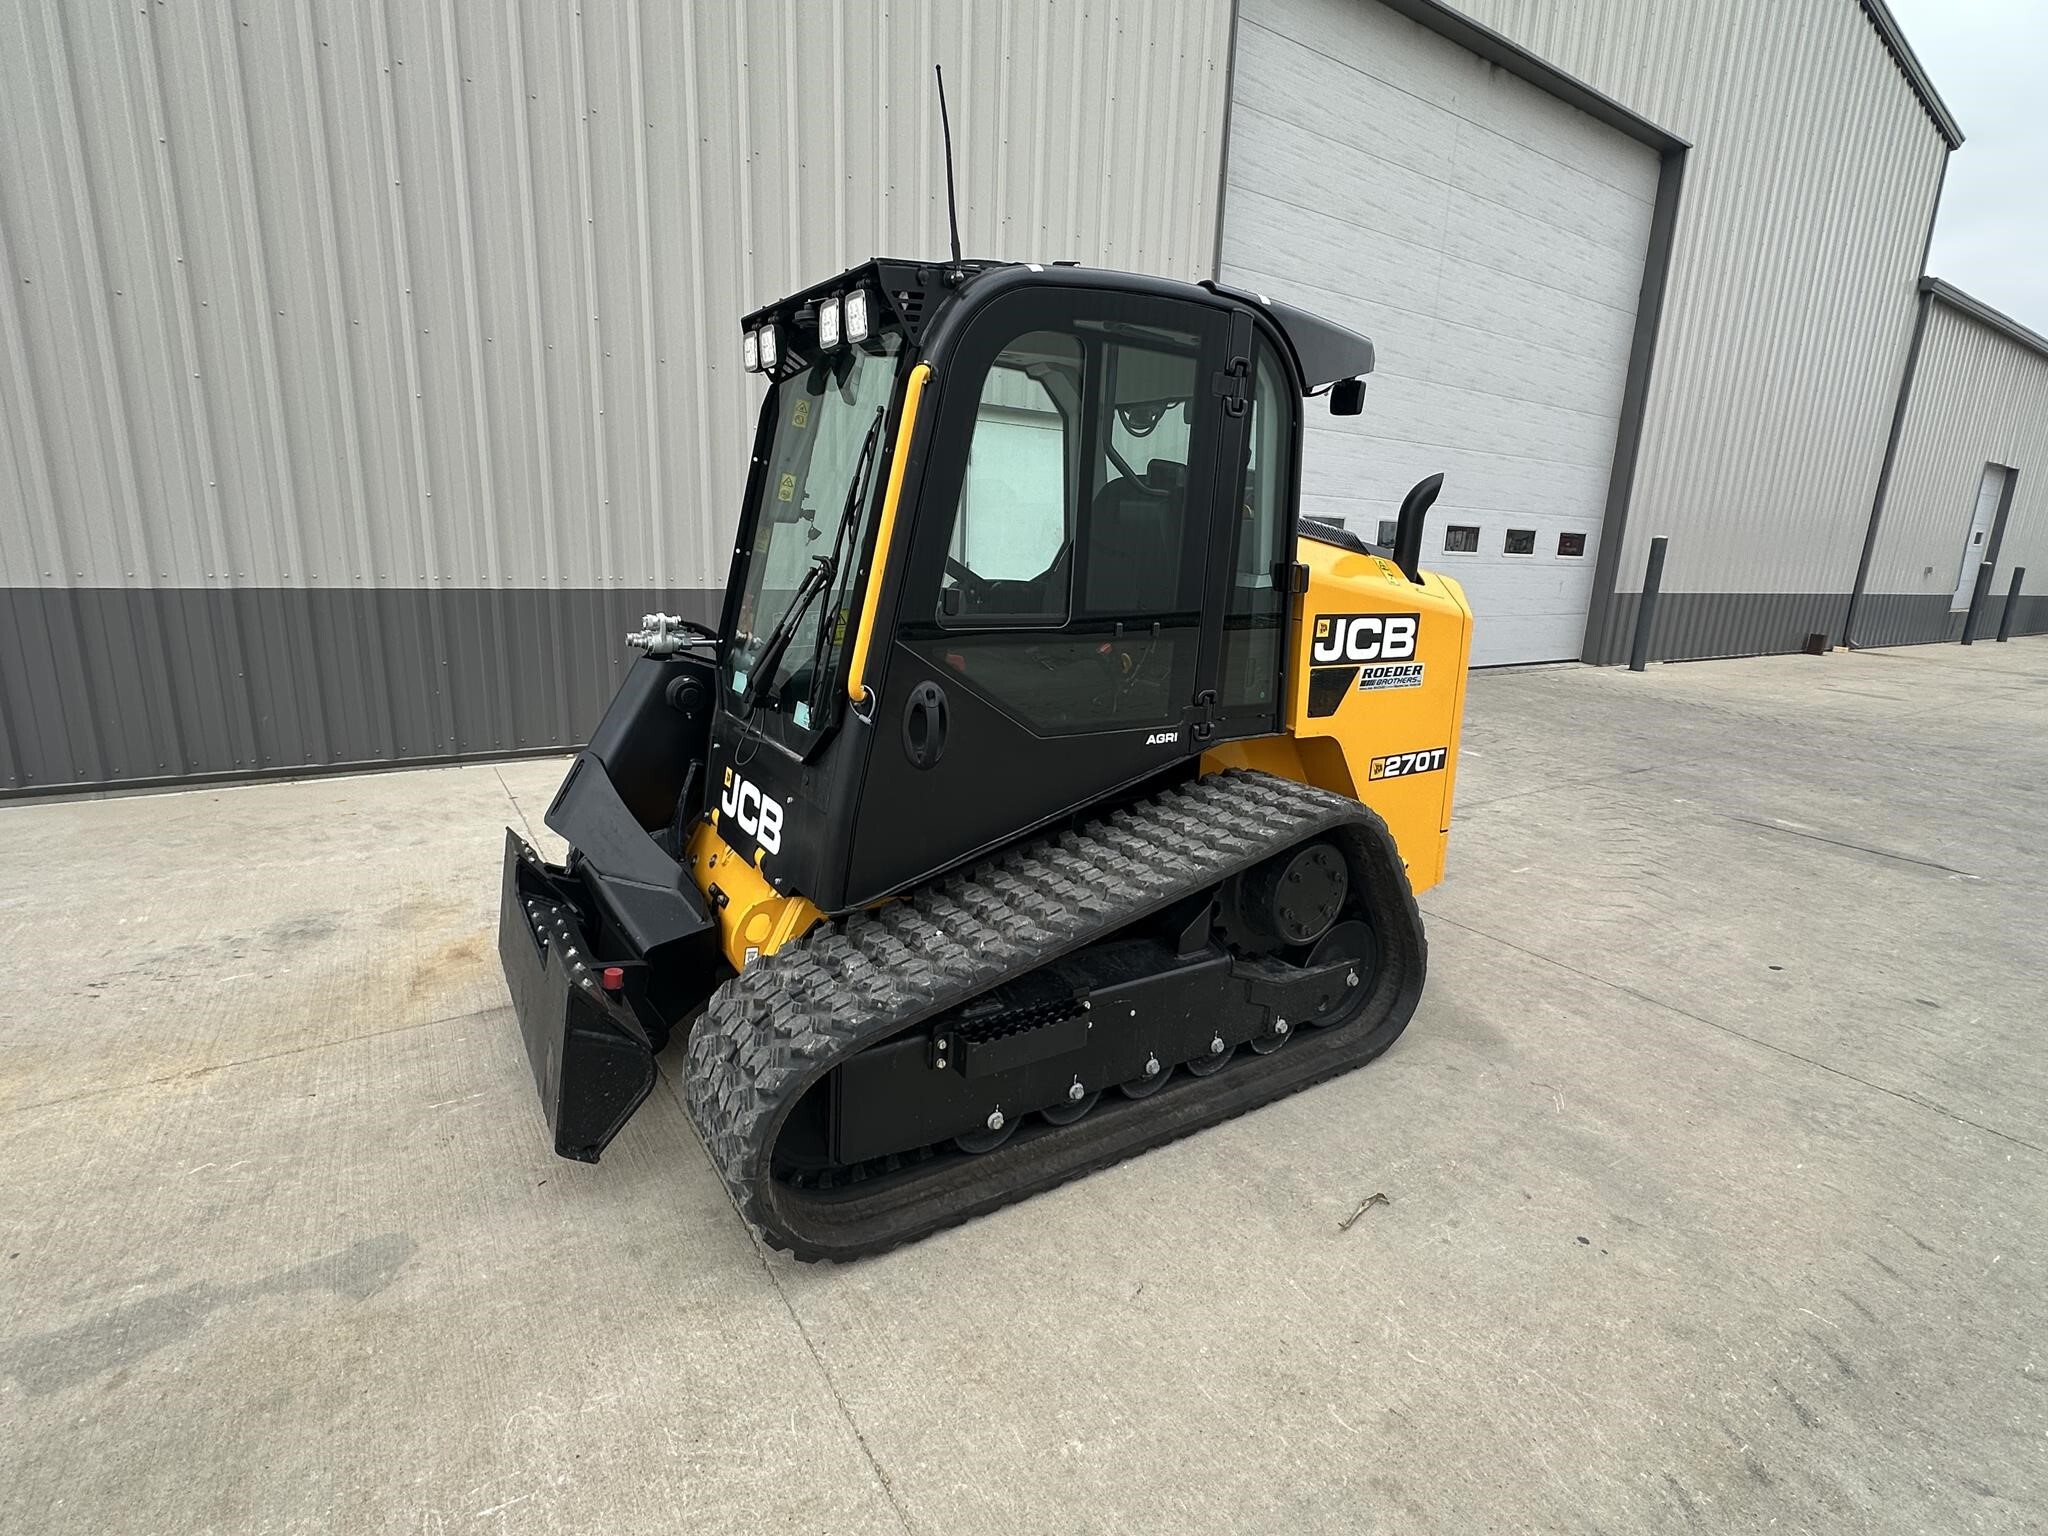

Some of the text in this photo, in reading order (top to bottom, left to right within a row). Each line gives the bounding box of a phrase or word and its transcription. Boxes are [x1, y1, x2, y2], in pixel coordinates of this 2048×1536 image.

[1314, 618, 1416, 661] JCB
[1362, 665, 1423, 679] ROEDER
[1376, 677, 1418, 686] BROTHERS
[1145, 732, 1178, 745] AGRI
[1384, 749, 1445, 777] 270T
[721, 773, 784, 855] JCB
